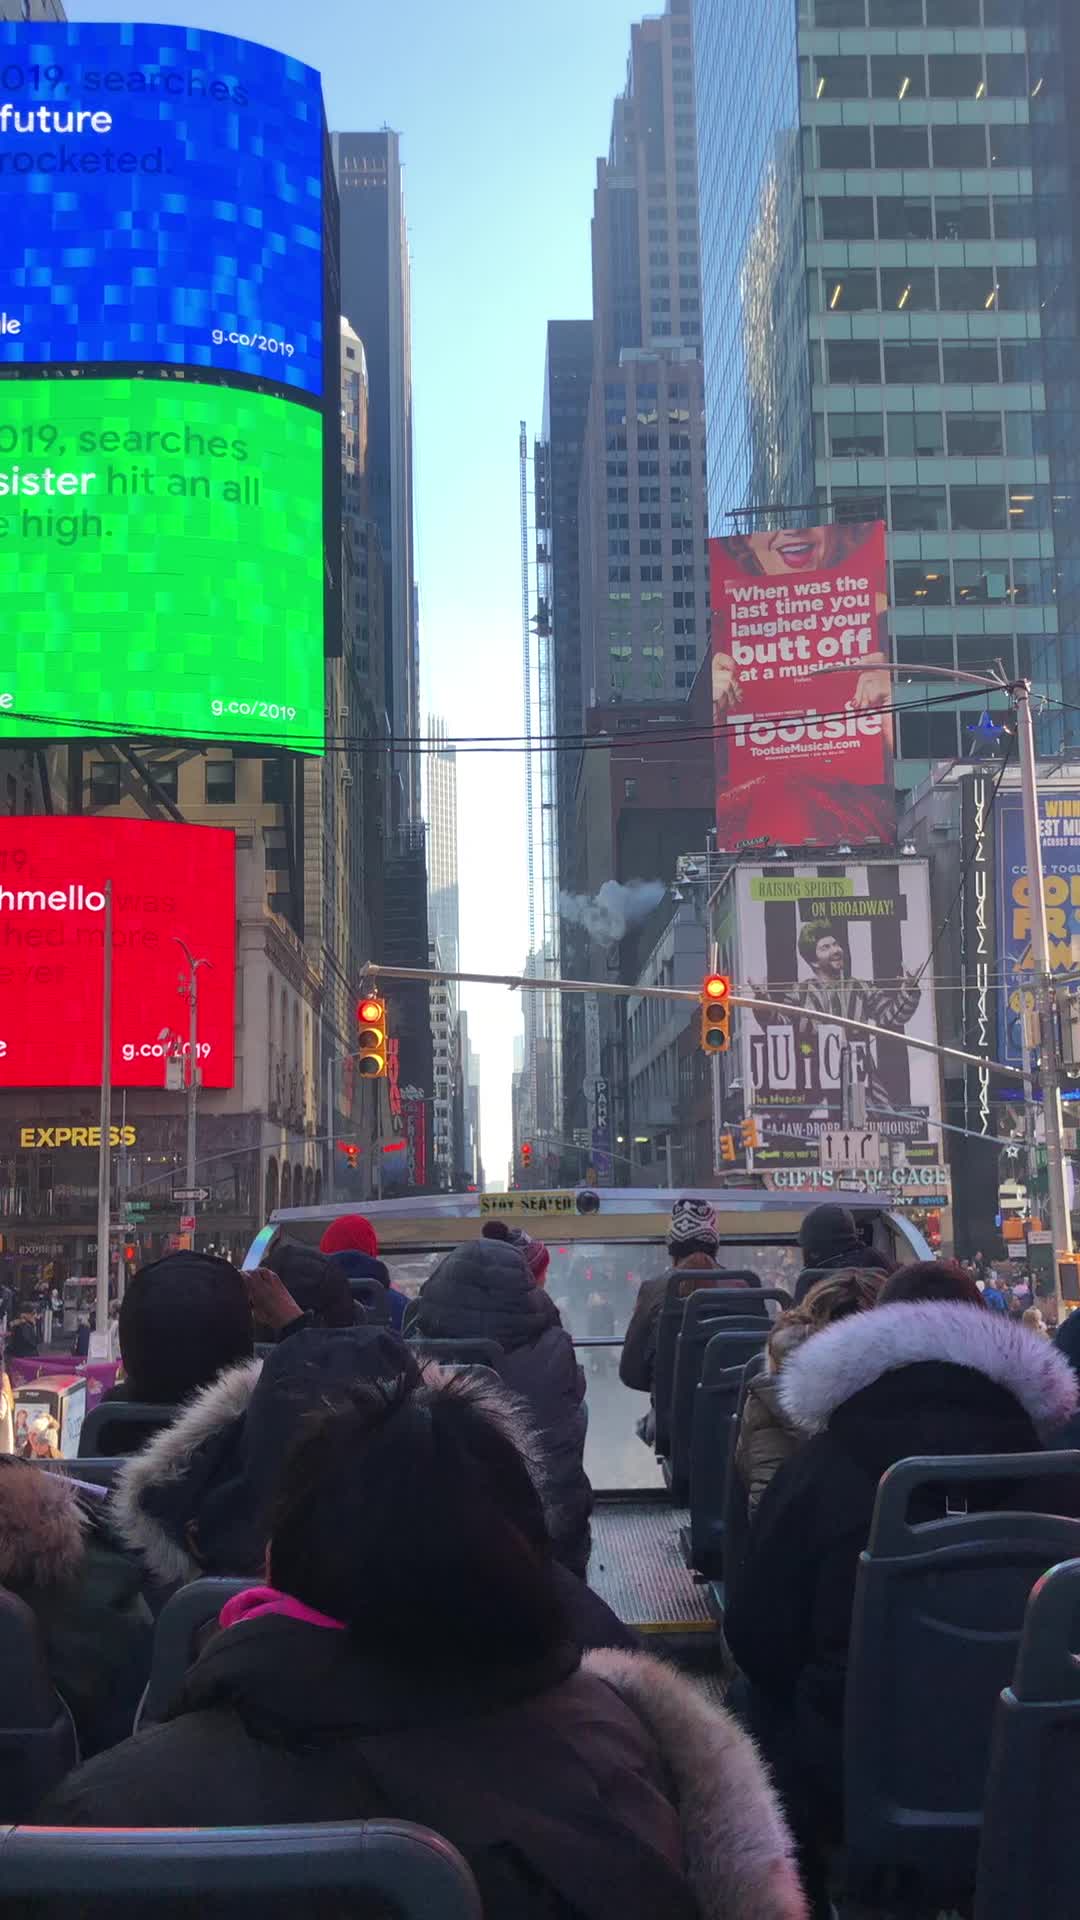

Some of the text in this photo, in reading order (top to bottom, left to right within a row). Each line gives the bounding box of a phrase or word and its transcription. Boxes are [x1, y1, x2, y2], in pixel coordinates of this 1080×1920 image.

[83, 69, 249, 106] searches
[0, 104, 112, 133] future
[211, 328, 295, 358] g.co/2019
[79, 425, 249, 461] searches
[0, 465, 259, 505] sister hit an all
[22, 508, 112, 546] high.
[794, 581, 831, 595] was
[836, 576, 868, 591] the
[731, 594, 870, 620] last time you
[731, 612, 871, 638] laughed your
[731, 628, 872, 666] butt off
[739, 667, 757, 682] at
[763, 668, 774, 679] a
[211, 698, 296, 721] g.co/2019
[727, 701, 882, 746] Tootsie
[750, 741, 860, 757] TootsieMusical.com
[1039, 819, 1059, 837] EST
[1012, 865, 1047, 874] COE
[759, 880, 845, 897] RAISING SPIRITS
[811, 899, 895, 916] ON BROADWAY!
[597, 1082, 607, 1129] PARK
[20, 1126, 136, 1148] EXPRESS
[782, 1121, 840, 1137] JAW-DROPP
[773, 1168, 835, 1187] GIFTS
